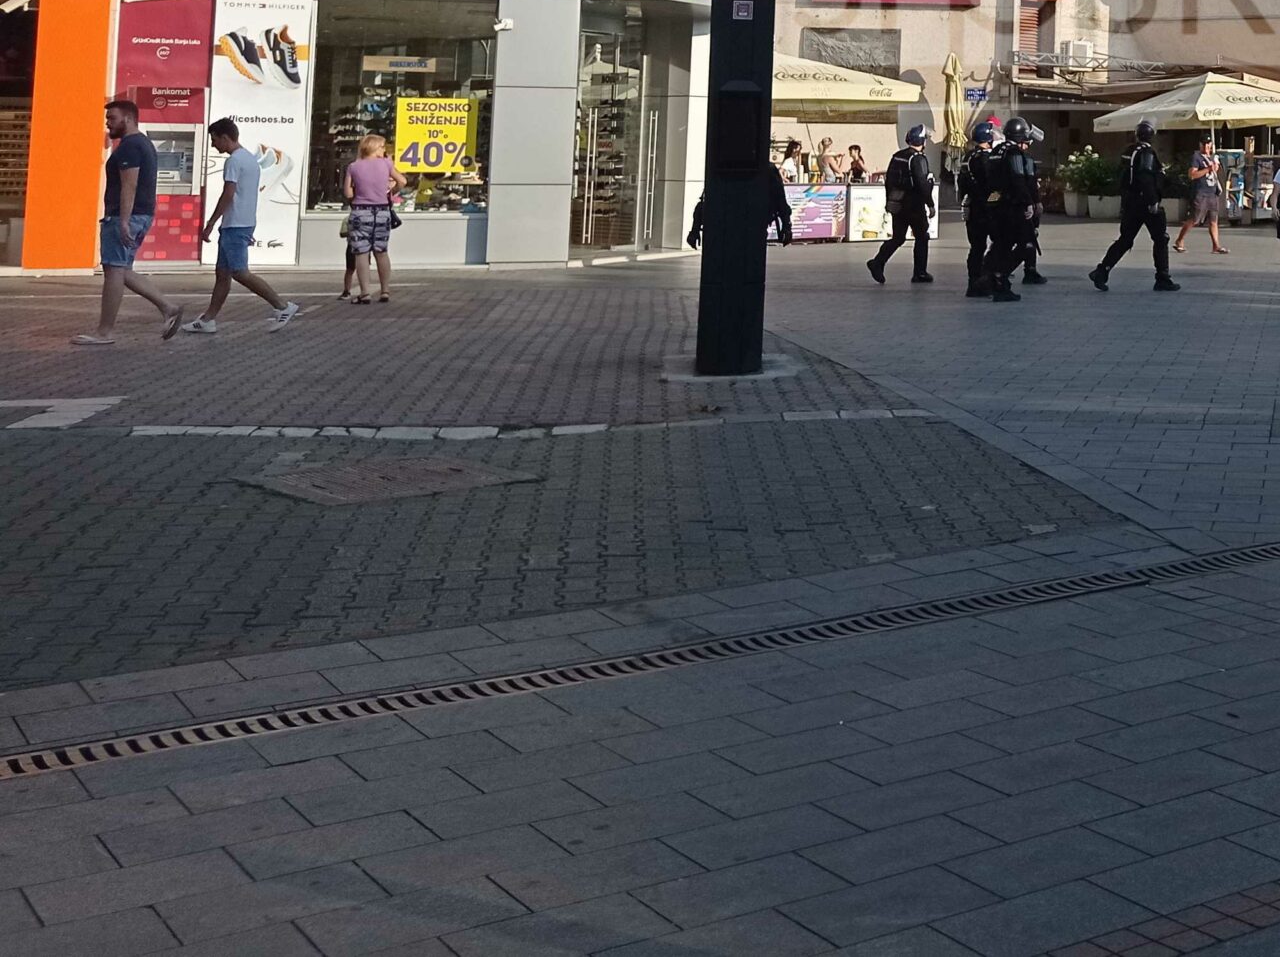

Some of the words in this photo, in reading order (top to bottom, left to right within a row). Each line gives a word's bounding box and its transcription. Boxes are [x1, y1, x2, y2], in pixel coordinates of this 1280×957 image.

[223, 1, 257, 9] TOMMY
[151, 87, 191, 96] Bankomat
[405, 102, 472, 113] SEZONSKO
[228, 114, 295, 125] fficeshoes.ba
[408, 112, 467, 126] SNIŽENJE
[399, 141, 473, 168] 40%
